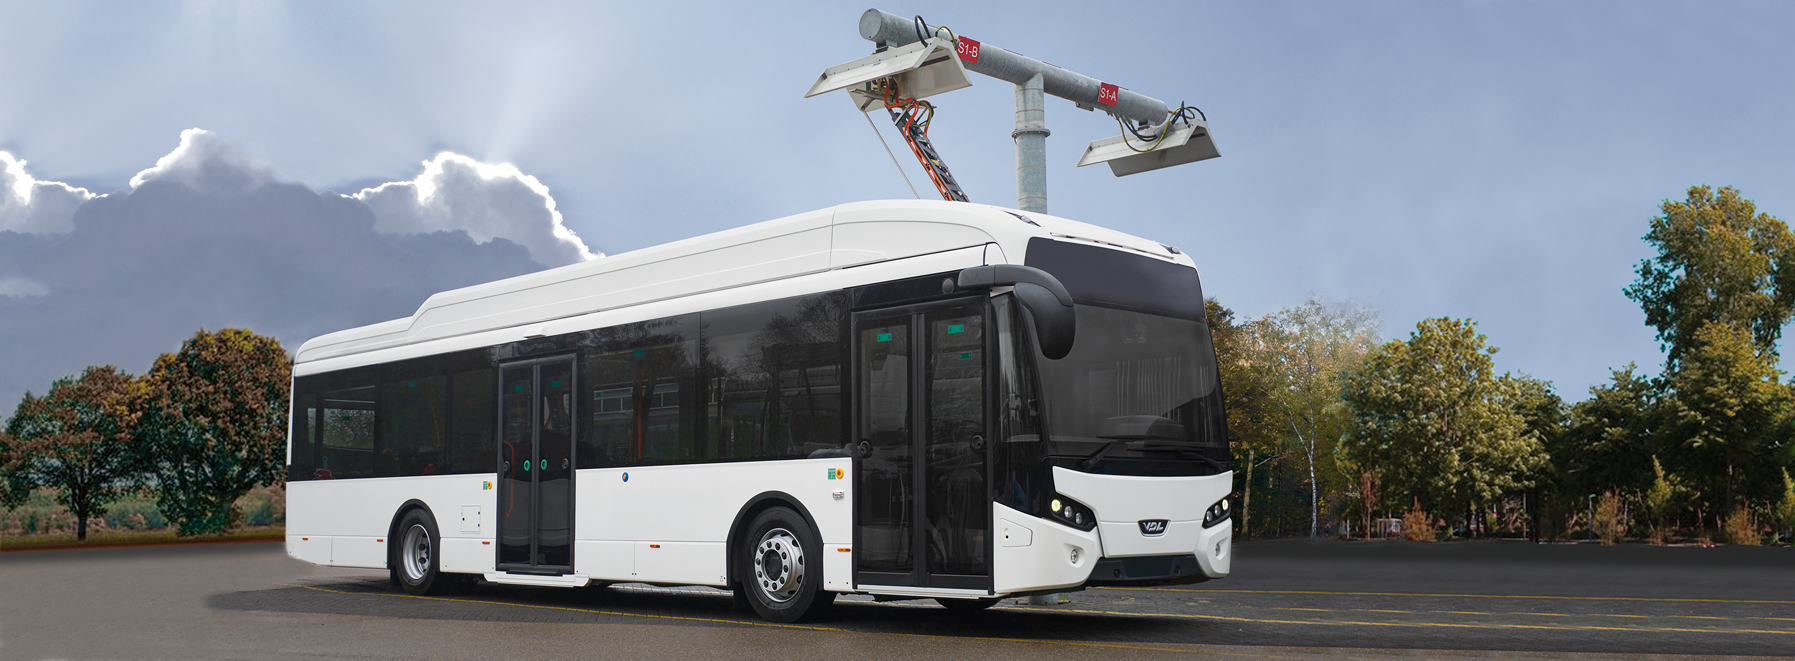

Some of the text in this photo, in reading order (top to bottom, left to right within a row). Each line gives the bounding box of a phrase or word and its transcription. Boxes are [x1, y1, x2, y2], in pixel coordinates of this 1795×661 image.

[958, 42, 978, 58] S1-B
[1100, 87, 1117, 101] S1-A
[1142, 521, 1164, 531] VDL
